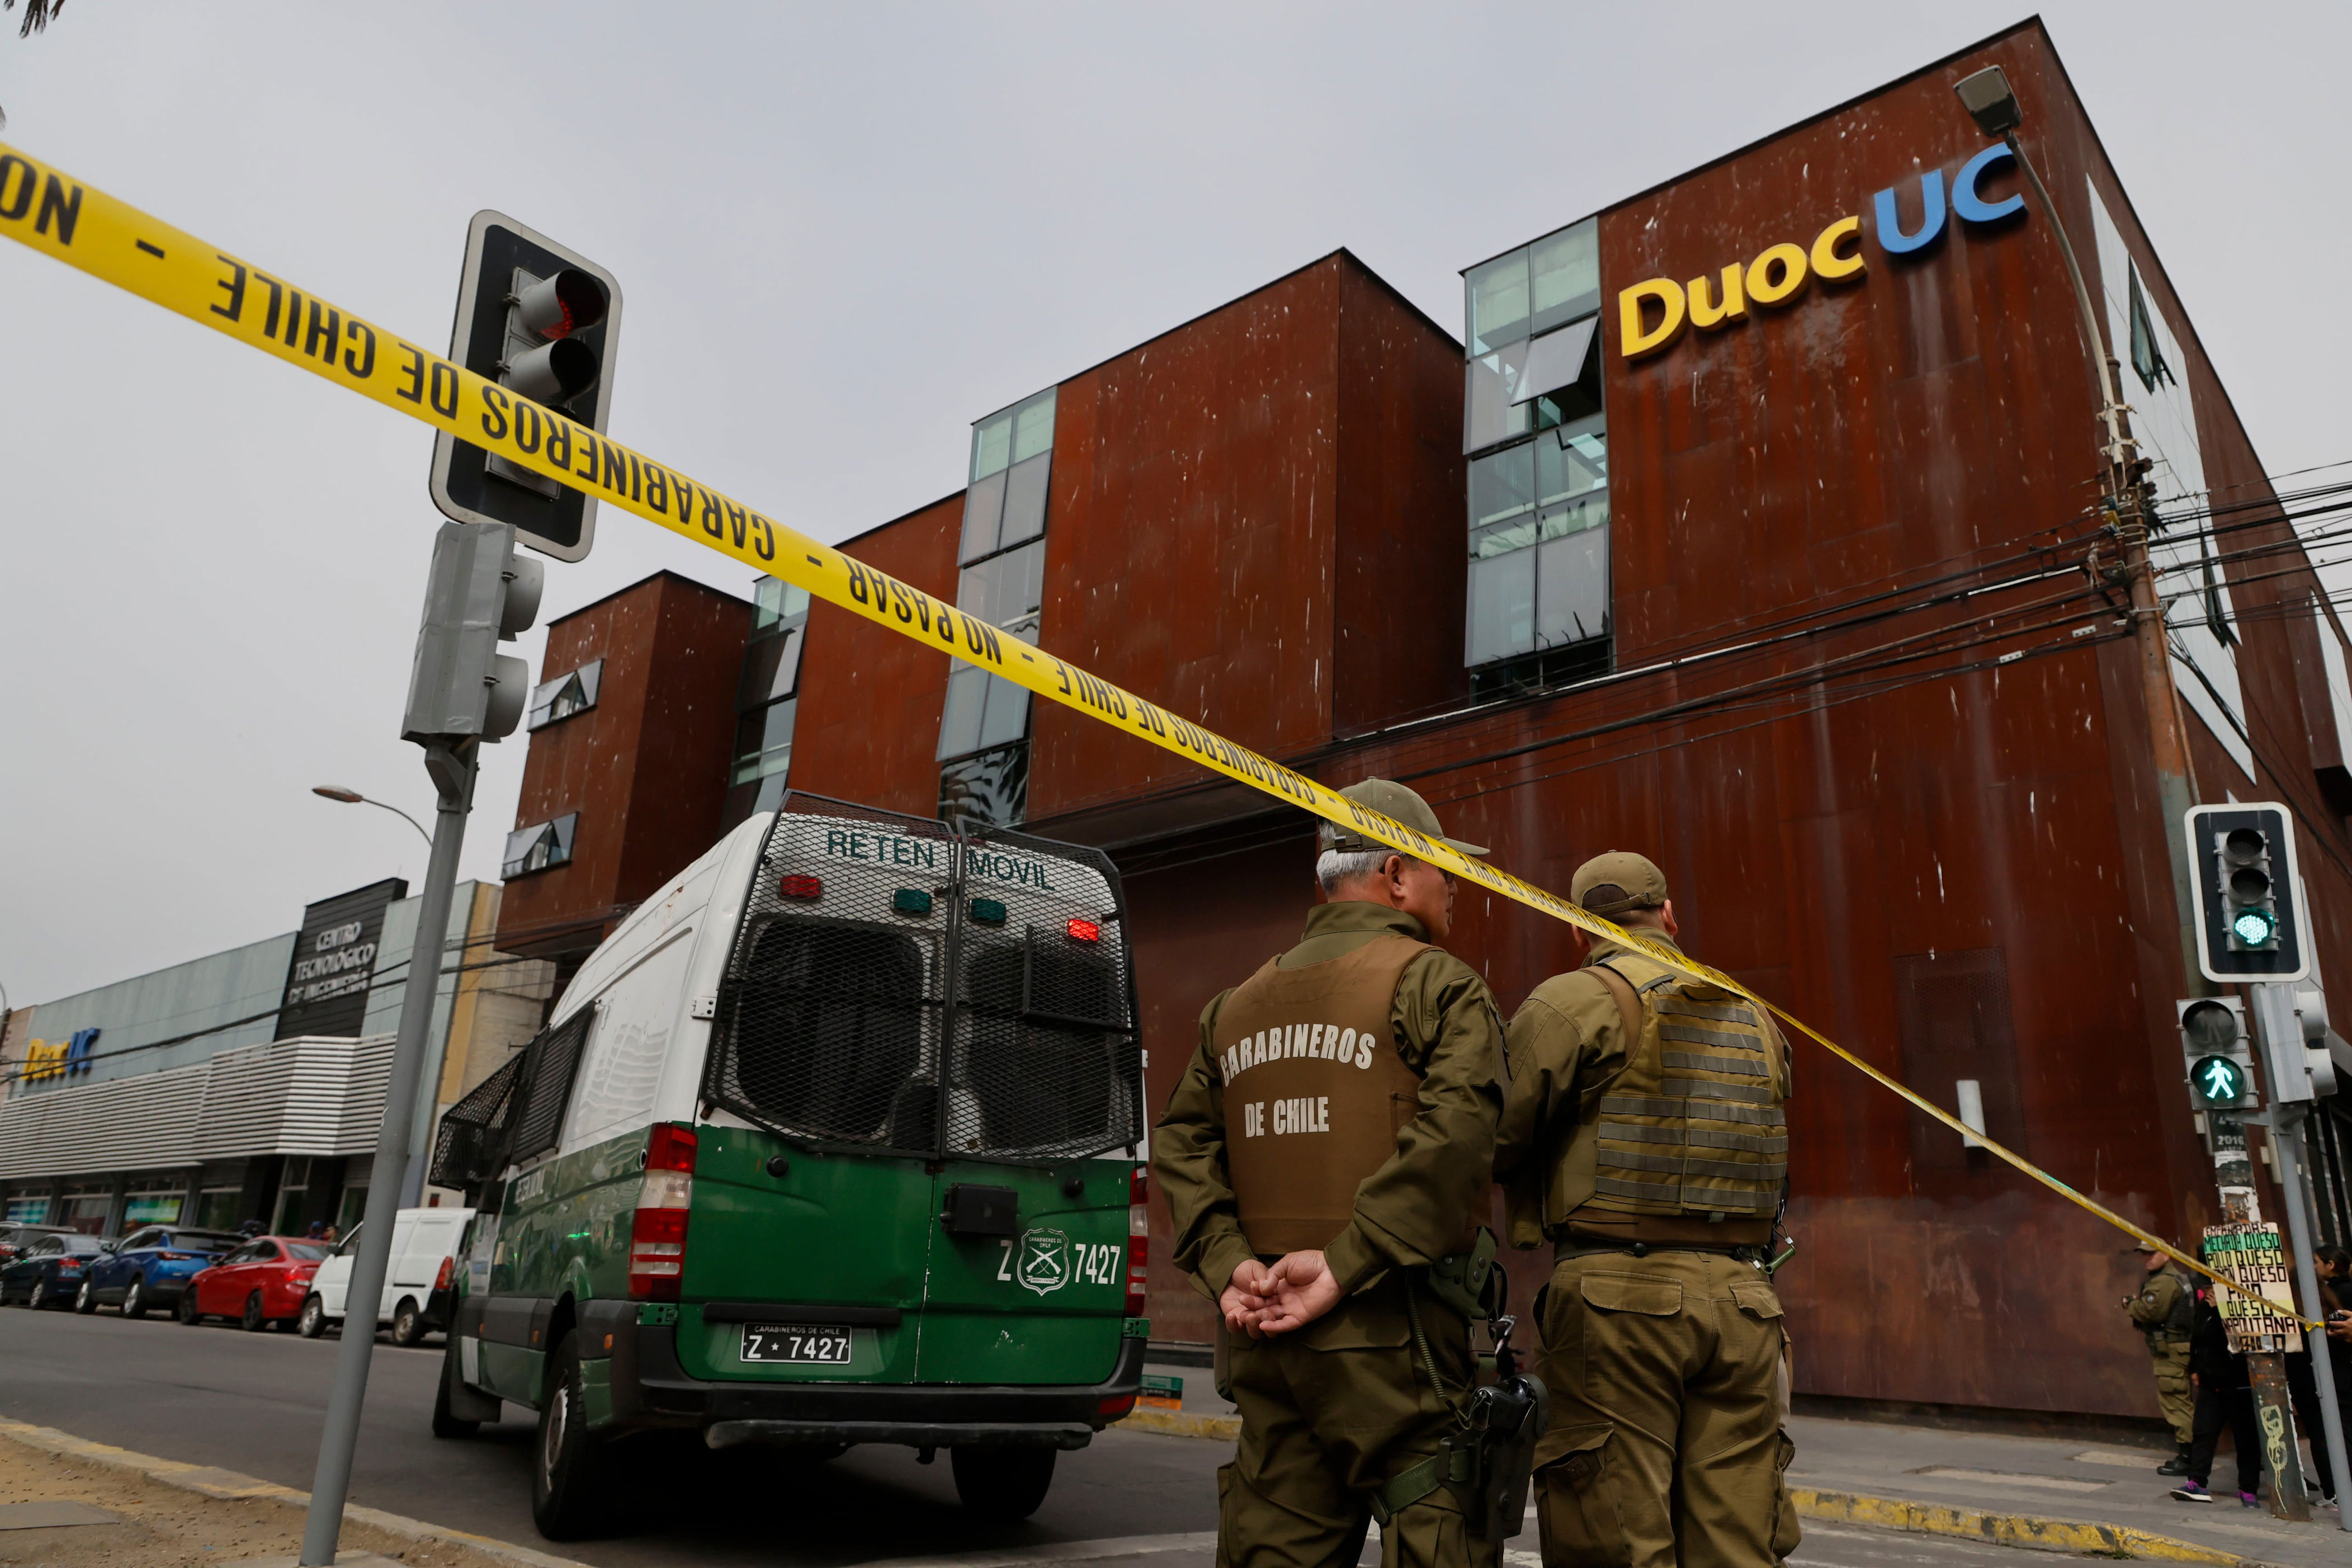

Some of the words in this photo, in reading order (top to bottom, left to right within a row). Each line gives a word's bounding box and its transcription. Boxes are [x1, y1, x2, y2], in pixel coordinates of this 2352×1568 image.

[0, 154, 83, 246] NO
[1619, 215, 1867, 360] Duoc
[1874, 141, 2028, 255] UC
[209, 254, 376, 379] CHILE
[396, 342, 460, 421] DE
[481, 385, 775, 561] CARABINEROS
[842, 556, 954, 644] PASAR
[961, 615, 1002, 665] NO
[1047, 655, 1127, 720] CHILE
[1127, 695, 1165, 738] DE
[1165, 711, 1316, 805] CARABINEROS
[1339, 794, 1409, 846] PASAR
[1401, 823, 1434, 857] NO
[828, 831, 934, 868] RETEN
[969, 849, 1055, 890] MOVIL
[1219, 1023, 1375, 1087] CARABINEROS
[1245, 1102, 1264, 1138] DE
[1273, 1097, 1329, 1135] CHILE
[997, 1240, 1013, 1281] Z
[1075, 1244, 1120, 1284] 7427
[2207, 1251, 2232, 1268] POLLO
[2236, 1250, 2285, 1267] QUESO
[2245, 1233, 2282, 1250] QUESO
[2239, 1266, 2287, 1282] QUESO
[2222, 1317, 2297, 1334] NAPOLITANA
[2227, 1300, 2274, 1316] QUESO
[747, 1335, 763, 1359] Z
[790, 1336, 847, 1359] 7427
